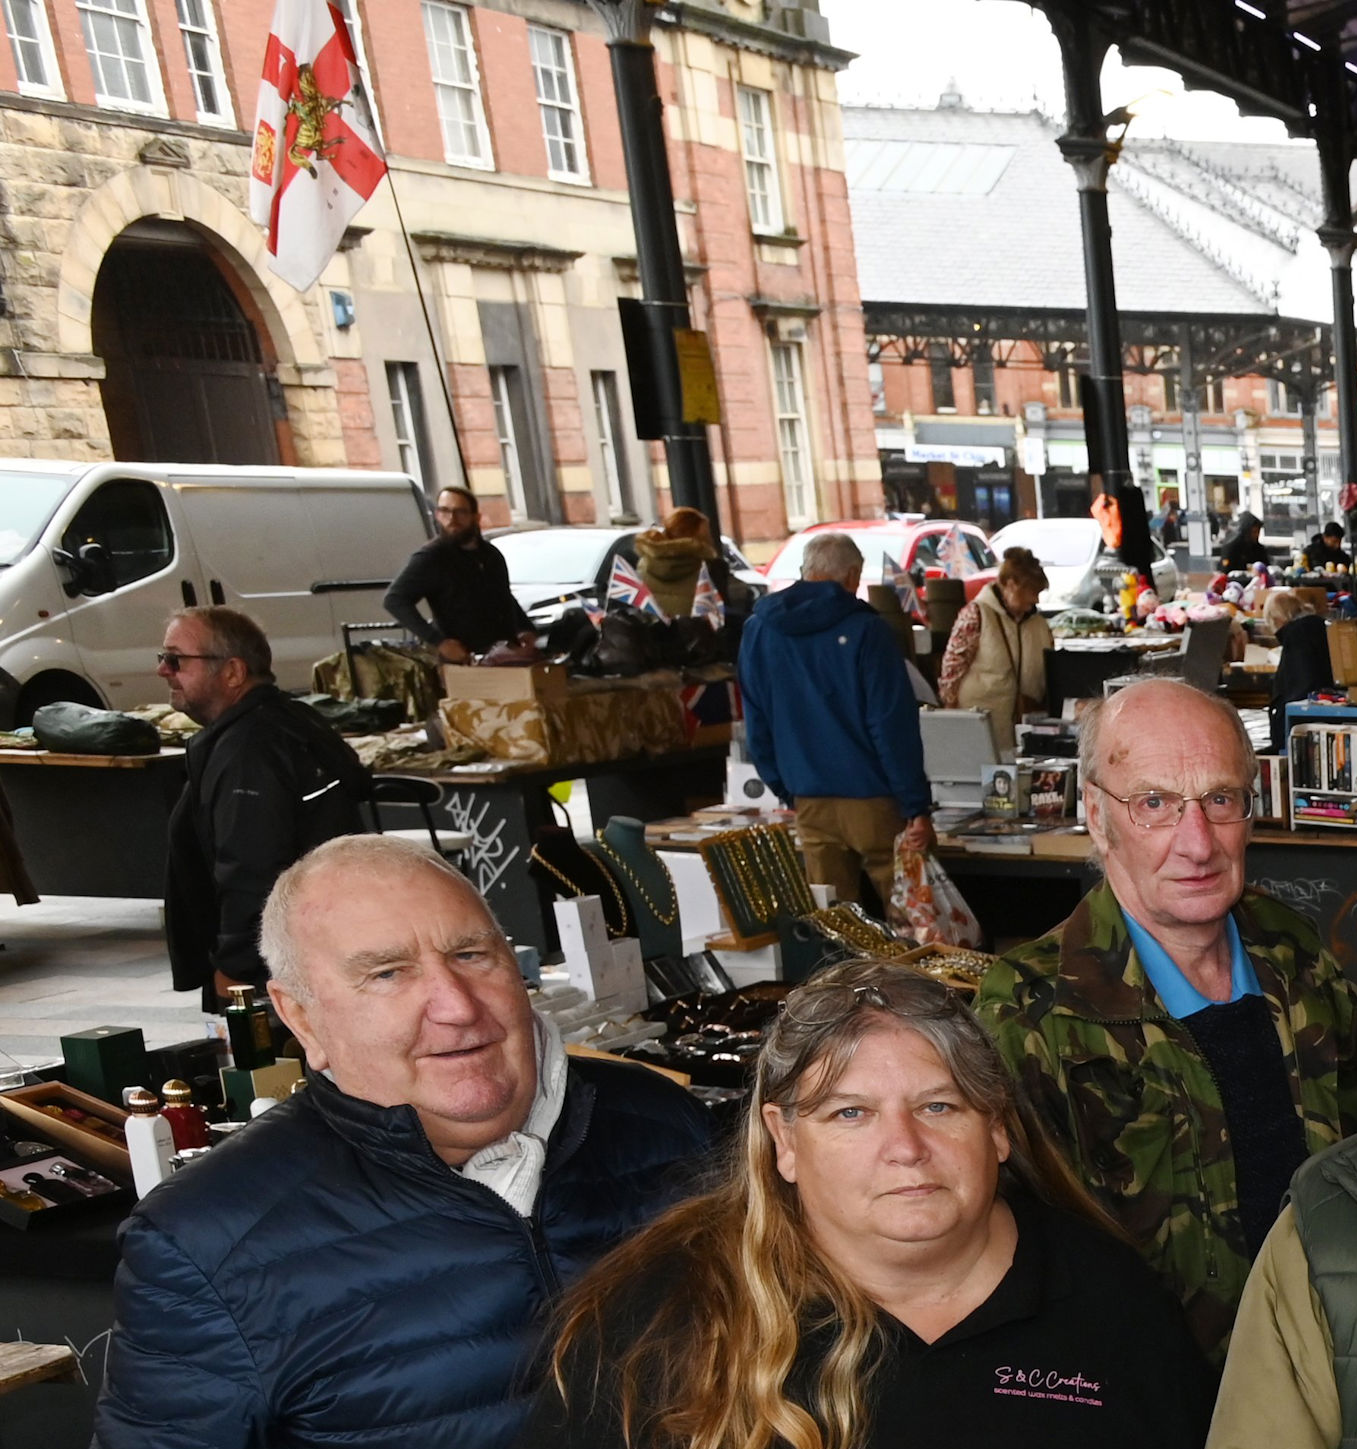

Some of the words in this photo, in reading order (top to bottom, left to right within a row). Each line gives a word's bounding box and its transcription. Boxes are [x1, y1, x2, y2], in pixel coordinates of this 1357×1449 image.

[995, 1366, 1013, 1384] S
[1016, 1369, 1026, 1382] &
[1029, 1369, 1044, 1387] C
[1046, 1371, 1100, 1394] Creations
